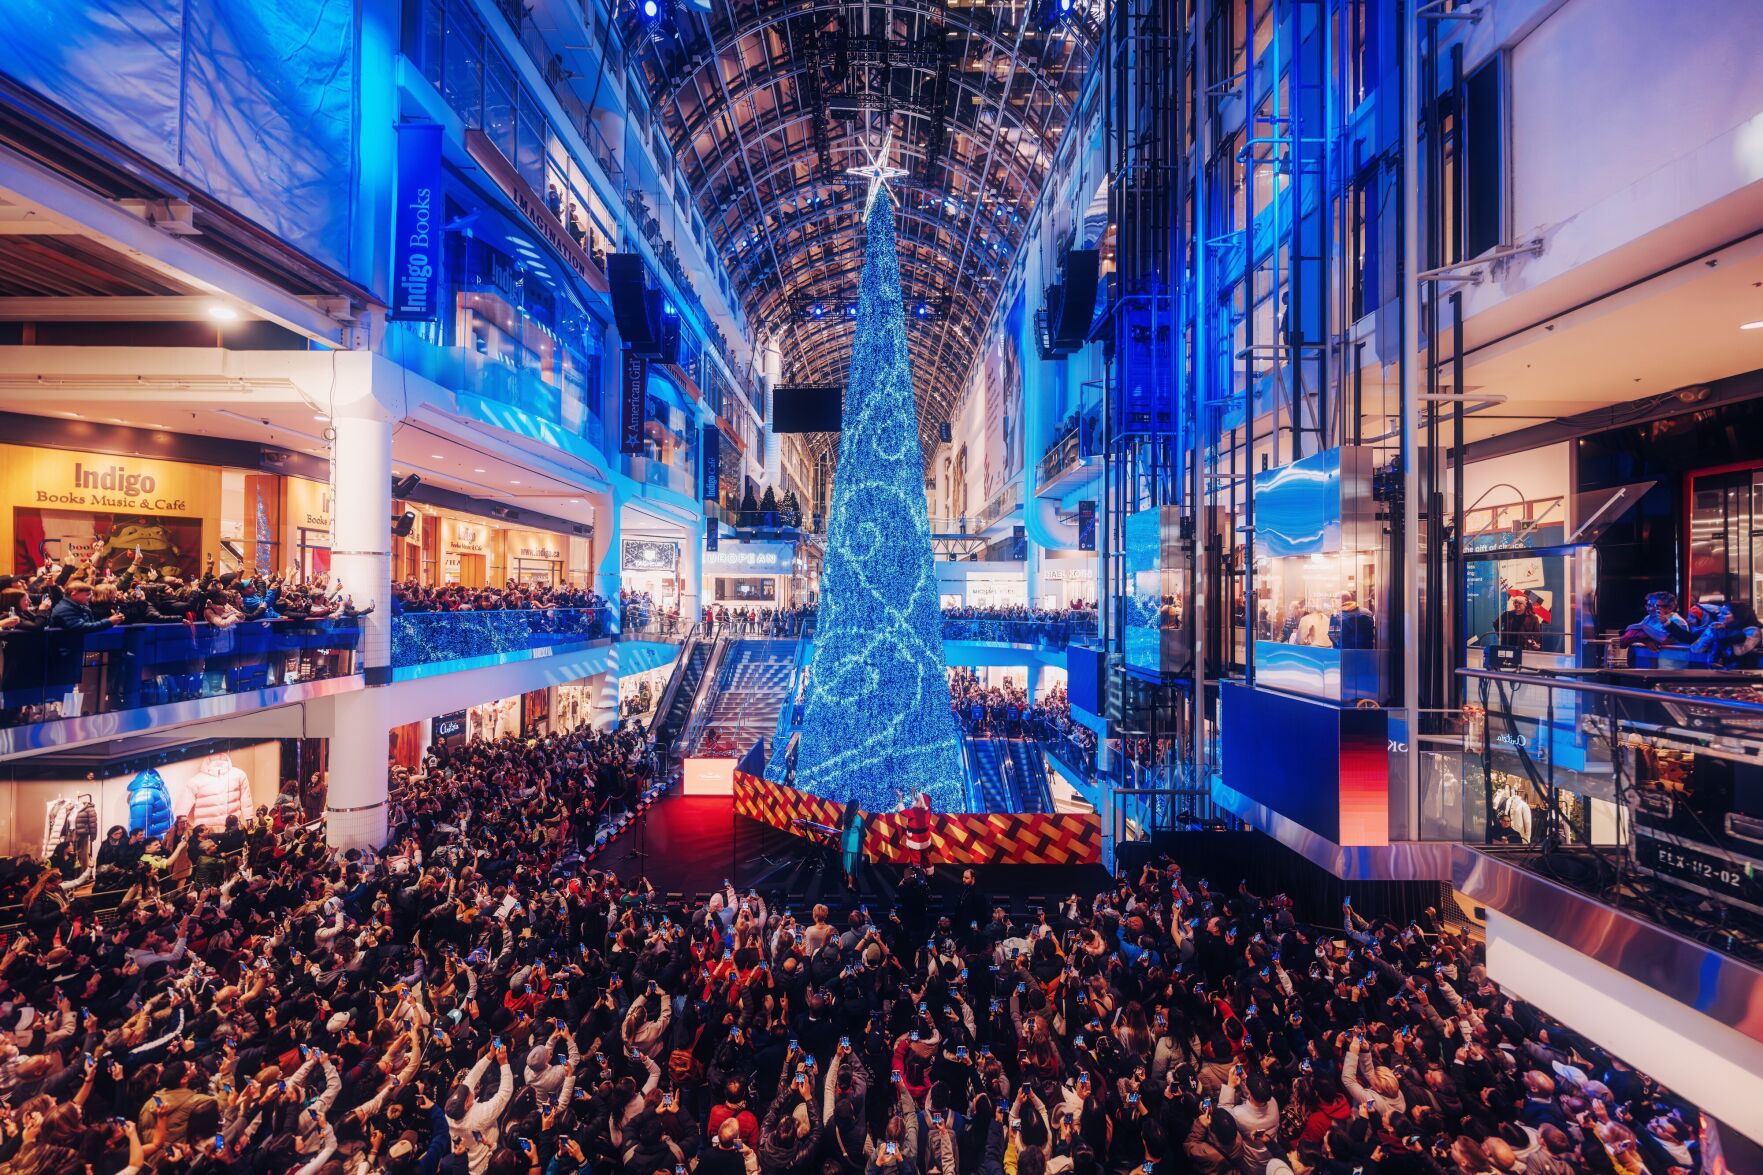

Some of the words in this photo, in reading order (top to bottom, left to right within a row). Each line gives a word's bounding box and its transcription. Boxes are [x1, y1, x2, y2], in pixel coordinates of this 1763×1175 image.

[409, 188, 431, 249] Books
[513, 187, 585, 278] IMAGINATION
[628, 379, 640, 433] American
[36, 490, 86, 505] Books
[91, 494, 136, 509] Music
[139, 498, 154, 511] &
[154, 499, 186, 511] Café
[307, 514, 328, 525] Books
[1489, 543, 1498, 551] of
[1498, 541, 1527, 550] chice.
[702, 552, 777, 564] UROPEAN
